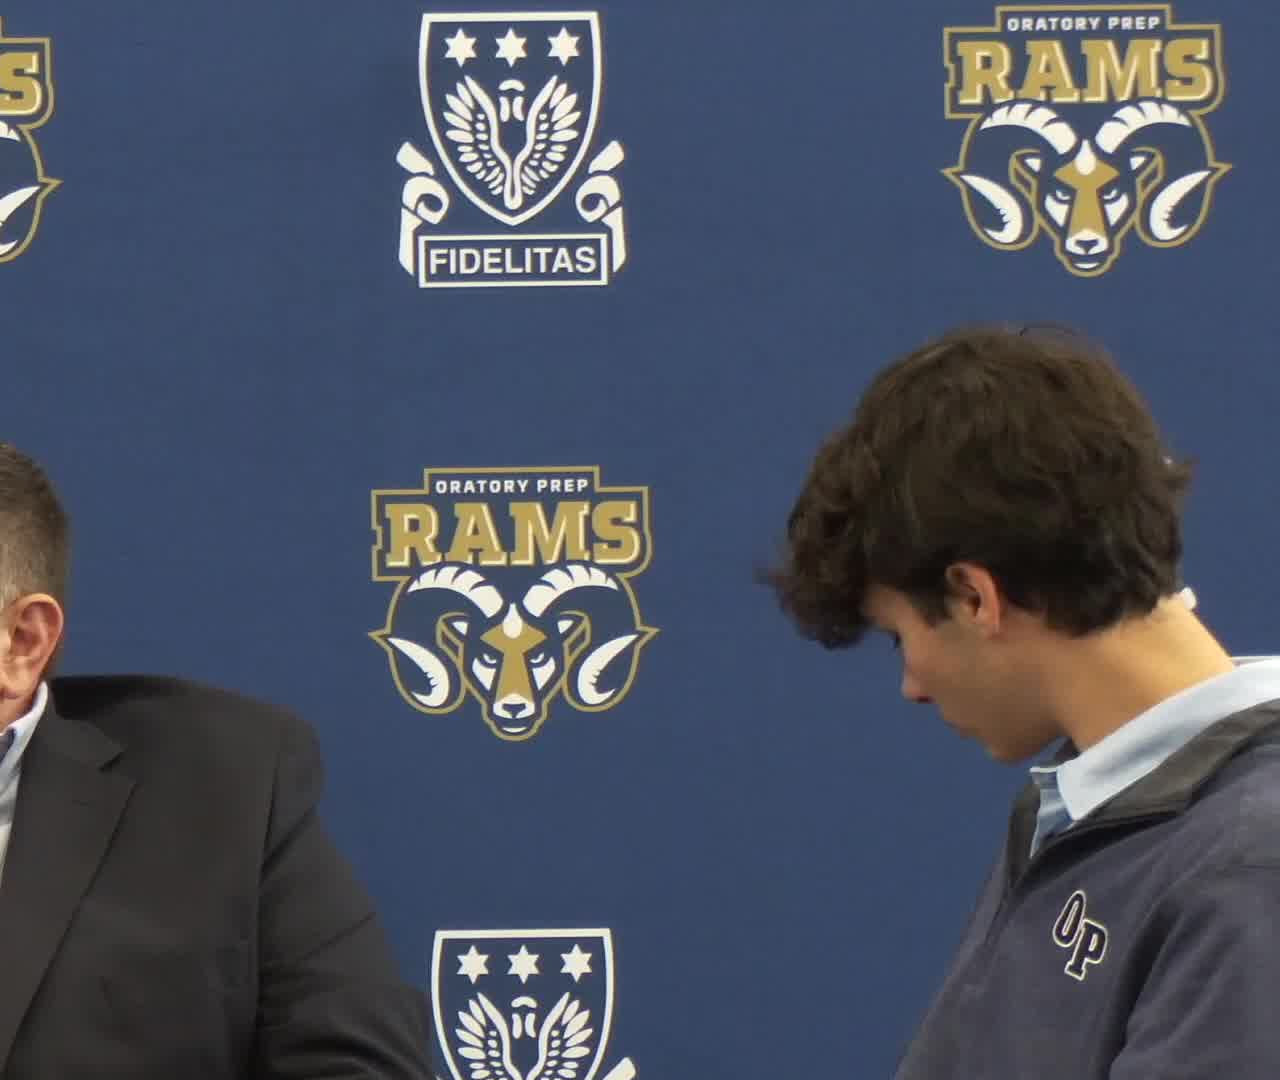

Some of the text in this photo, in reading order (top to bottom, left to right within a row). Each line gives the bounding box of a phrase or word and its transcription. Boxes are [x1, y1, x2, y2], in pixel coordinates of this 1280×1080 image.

[1007, 16, 1160, 31] ORATORY PREP
[959, 39, 1212, 103] RAMS
[430, 246, 596, 273] FIDELITAS
[436, 479, 588, 493] ORATORY PREP
[384, 502, 641, 566] RAMS
